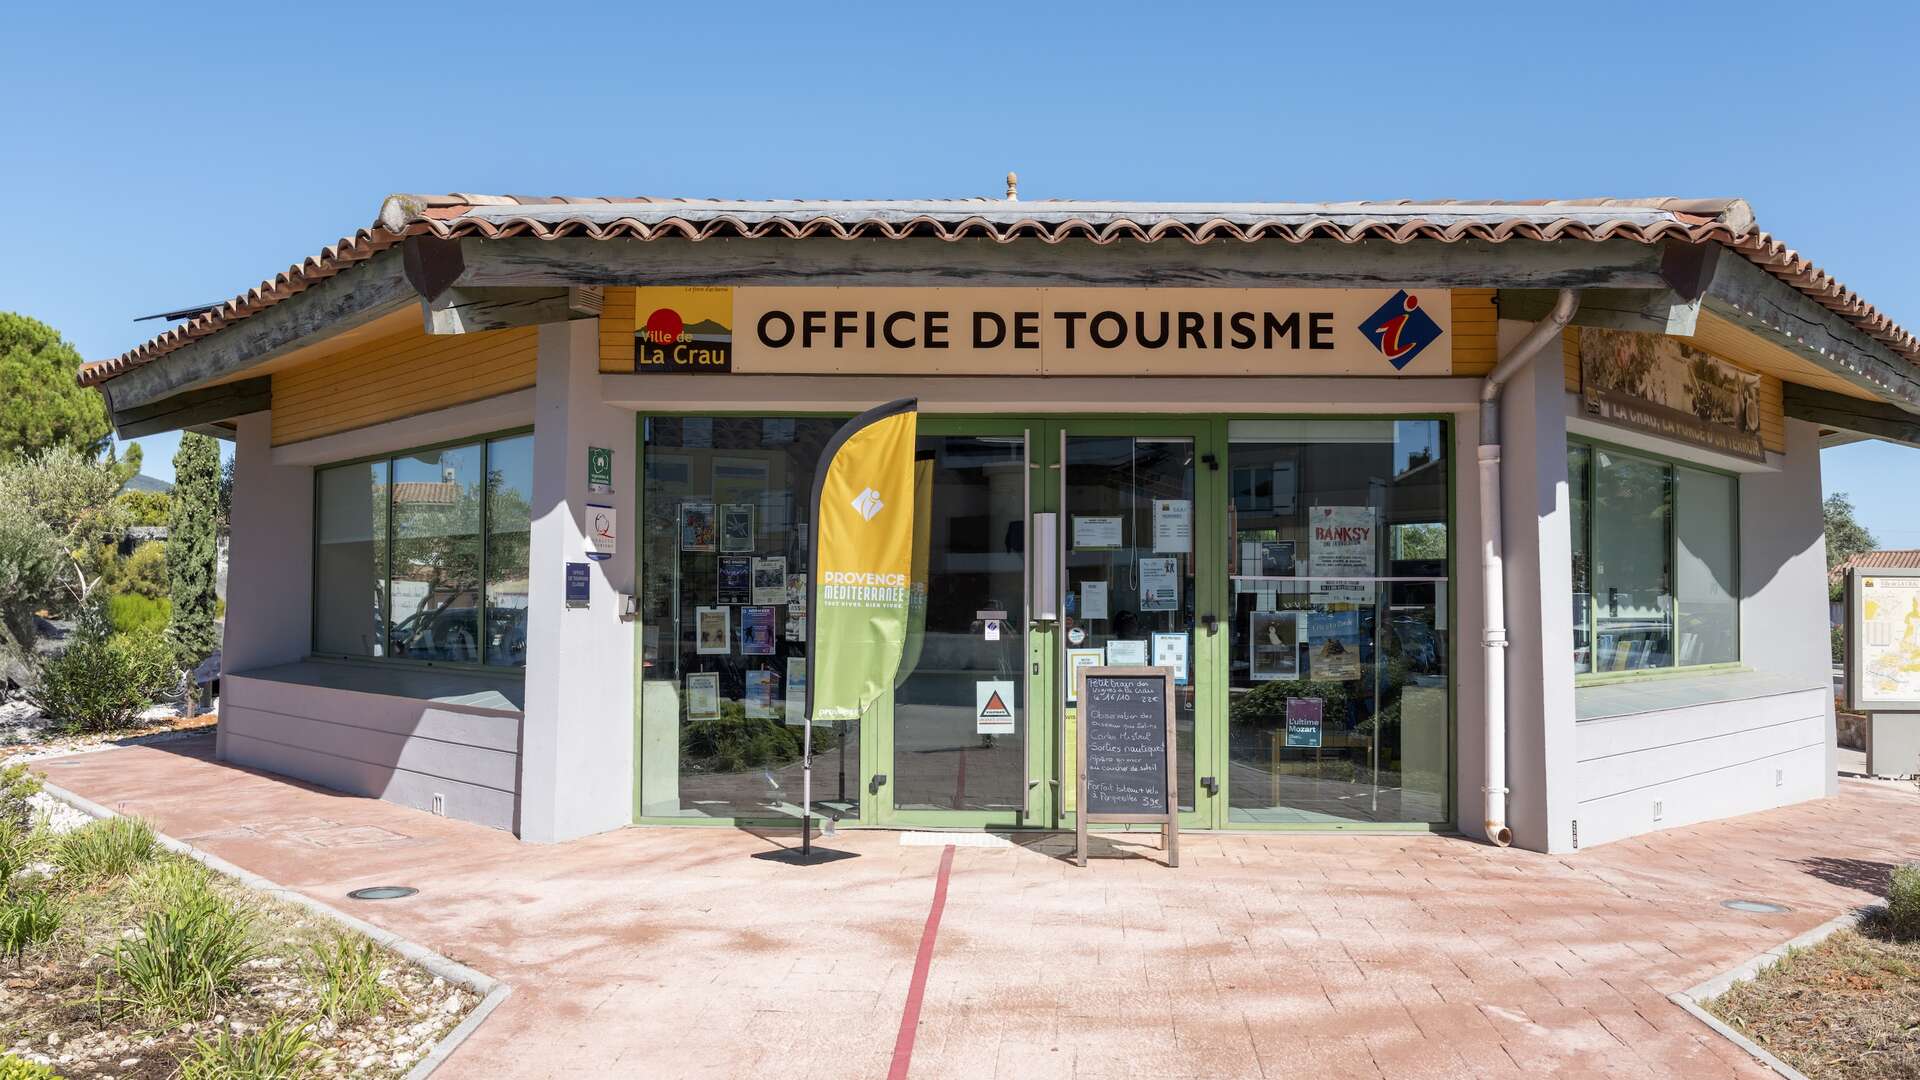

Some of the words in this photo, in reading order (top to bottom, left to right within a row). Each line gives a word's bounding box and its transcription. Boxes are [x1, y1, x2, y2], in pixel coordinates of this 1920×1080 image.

[641, 330, 672, 343] Ville
[676, 330, 694, 343] de
[757, 310, 949, 349] OFFICE
[972, 311, 1040, 349] DE
[1054, 310, 1334, 350] TOURISME
[640, 345, 665, 364] La
[673, 345, 725, 364] Crau
[1613, 404, 1628, 420] LA
[1315, 527, 1369, 541] BANKSY
[824, 572, 905, 586] PROVENCE
[1289, 718, 1319, 726] L'ultime
[1289, 725, 1316, 733] Mozart
[1090, 742, 1121, 752] Sorties
[1139, 763, 1157, 772] soleil
[1088, 780, 1114, 791] Forfait
